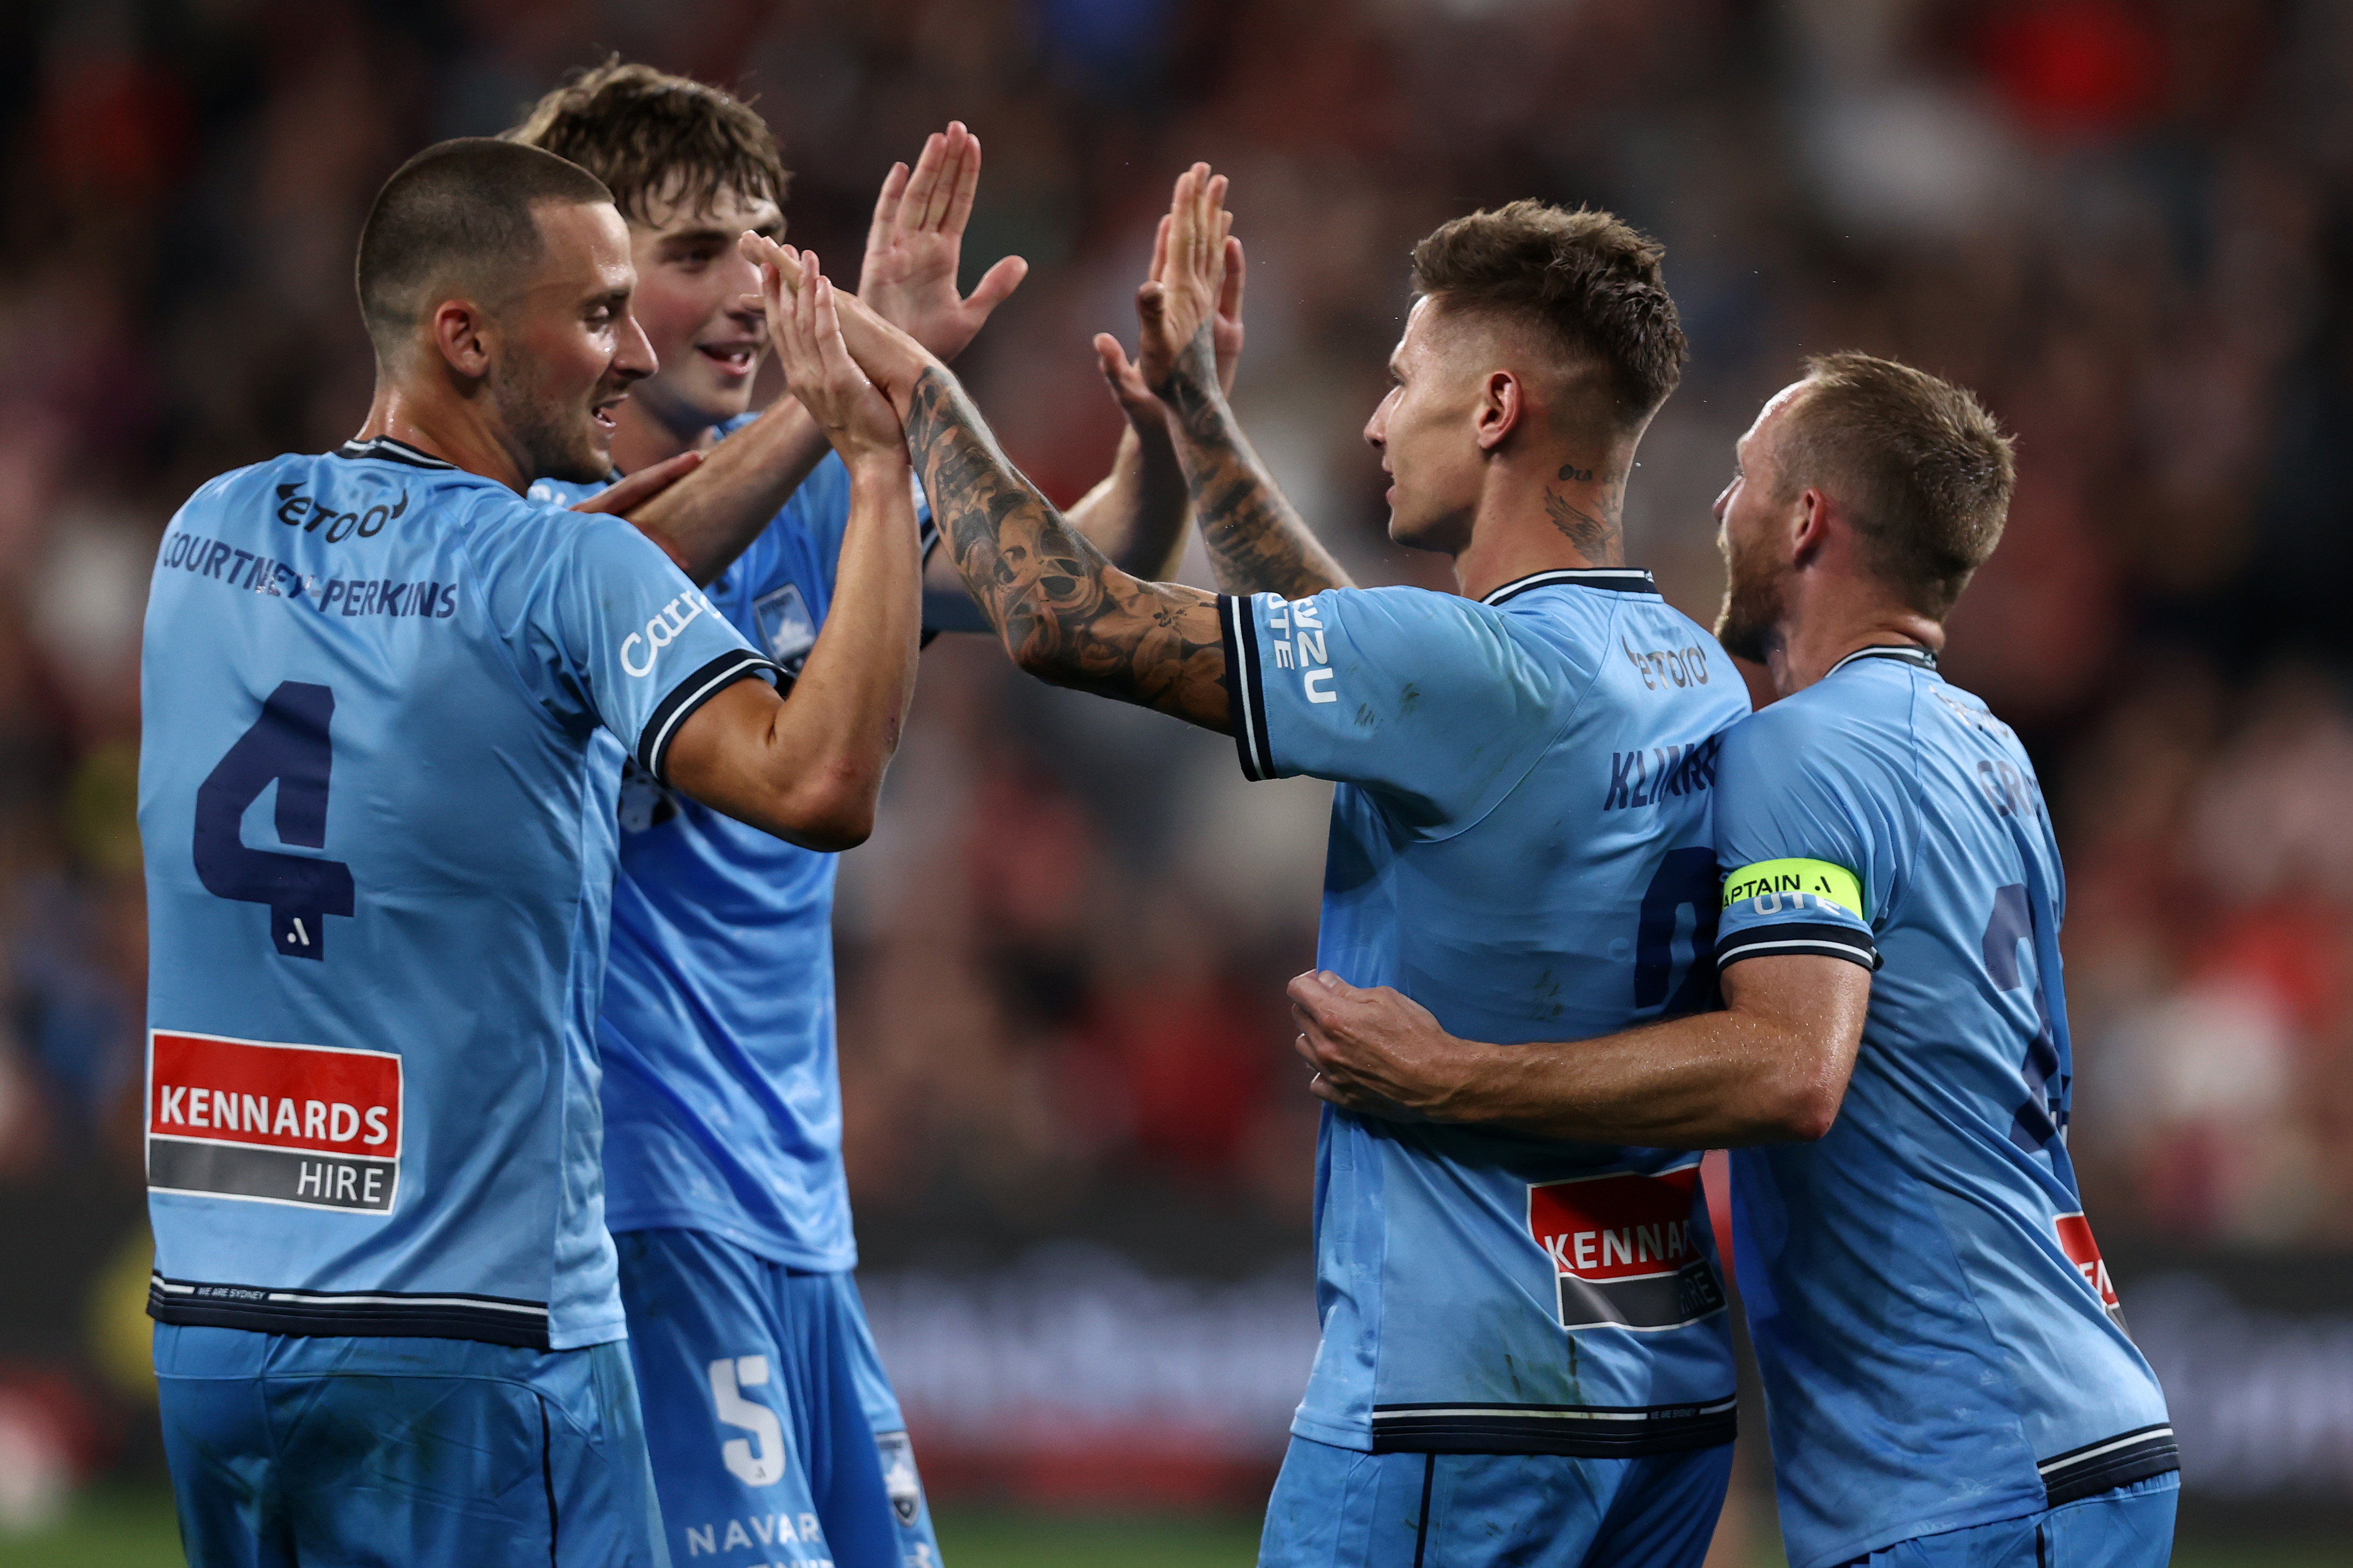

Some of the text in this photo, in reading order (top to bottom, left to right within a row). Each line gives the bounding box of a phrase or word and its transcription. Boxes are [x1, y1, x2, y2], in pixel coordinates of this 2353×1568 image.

[193, 680, 355, 961] 4
[1723, 874, 1801, 907] APTAIN
[160, 1085, 389, 1145] KENNARDS
[296, 1161, 384, 1203] HIRE
[709, 1355, 785, 1487] 5
[685, 1511, 821, 1557] NAVAR
